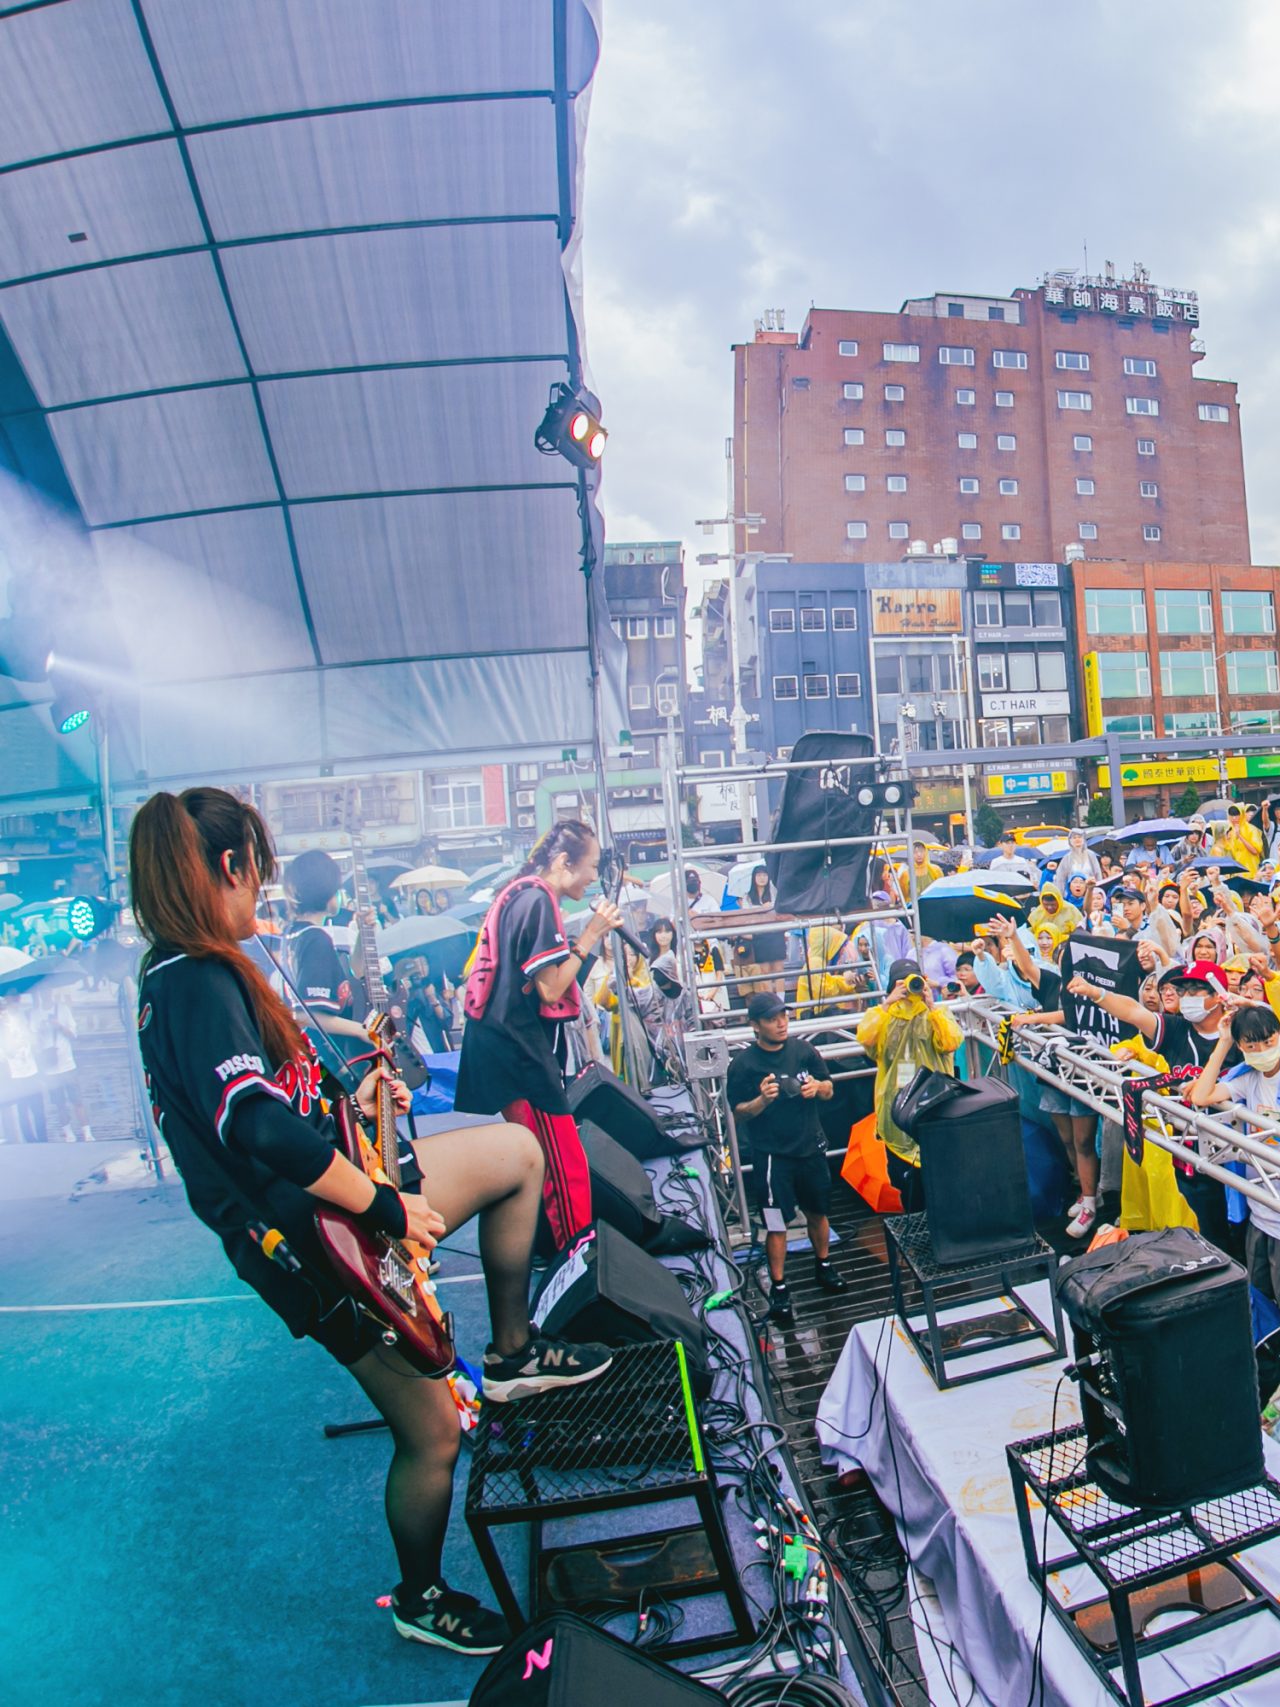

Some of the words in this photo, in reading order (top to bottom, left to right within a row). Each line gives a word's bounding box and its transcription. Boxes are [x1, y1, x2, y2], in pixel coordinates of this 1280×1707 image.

[1044, 285, 1200, 321] 華帥海景飯店
[990, 701, 1007, 711] C.T
[1010, 699, 1037, 710] HAIR
[1143, 766, 1207, 779] 國泰世華銀行
[542, 1349, 564, 1367] N
[437, 1613, 461, 1633] N
